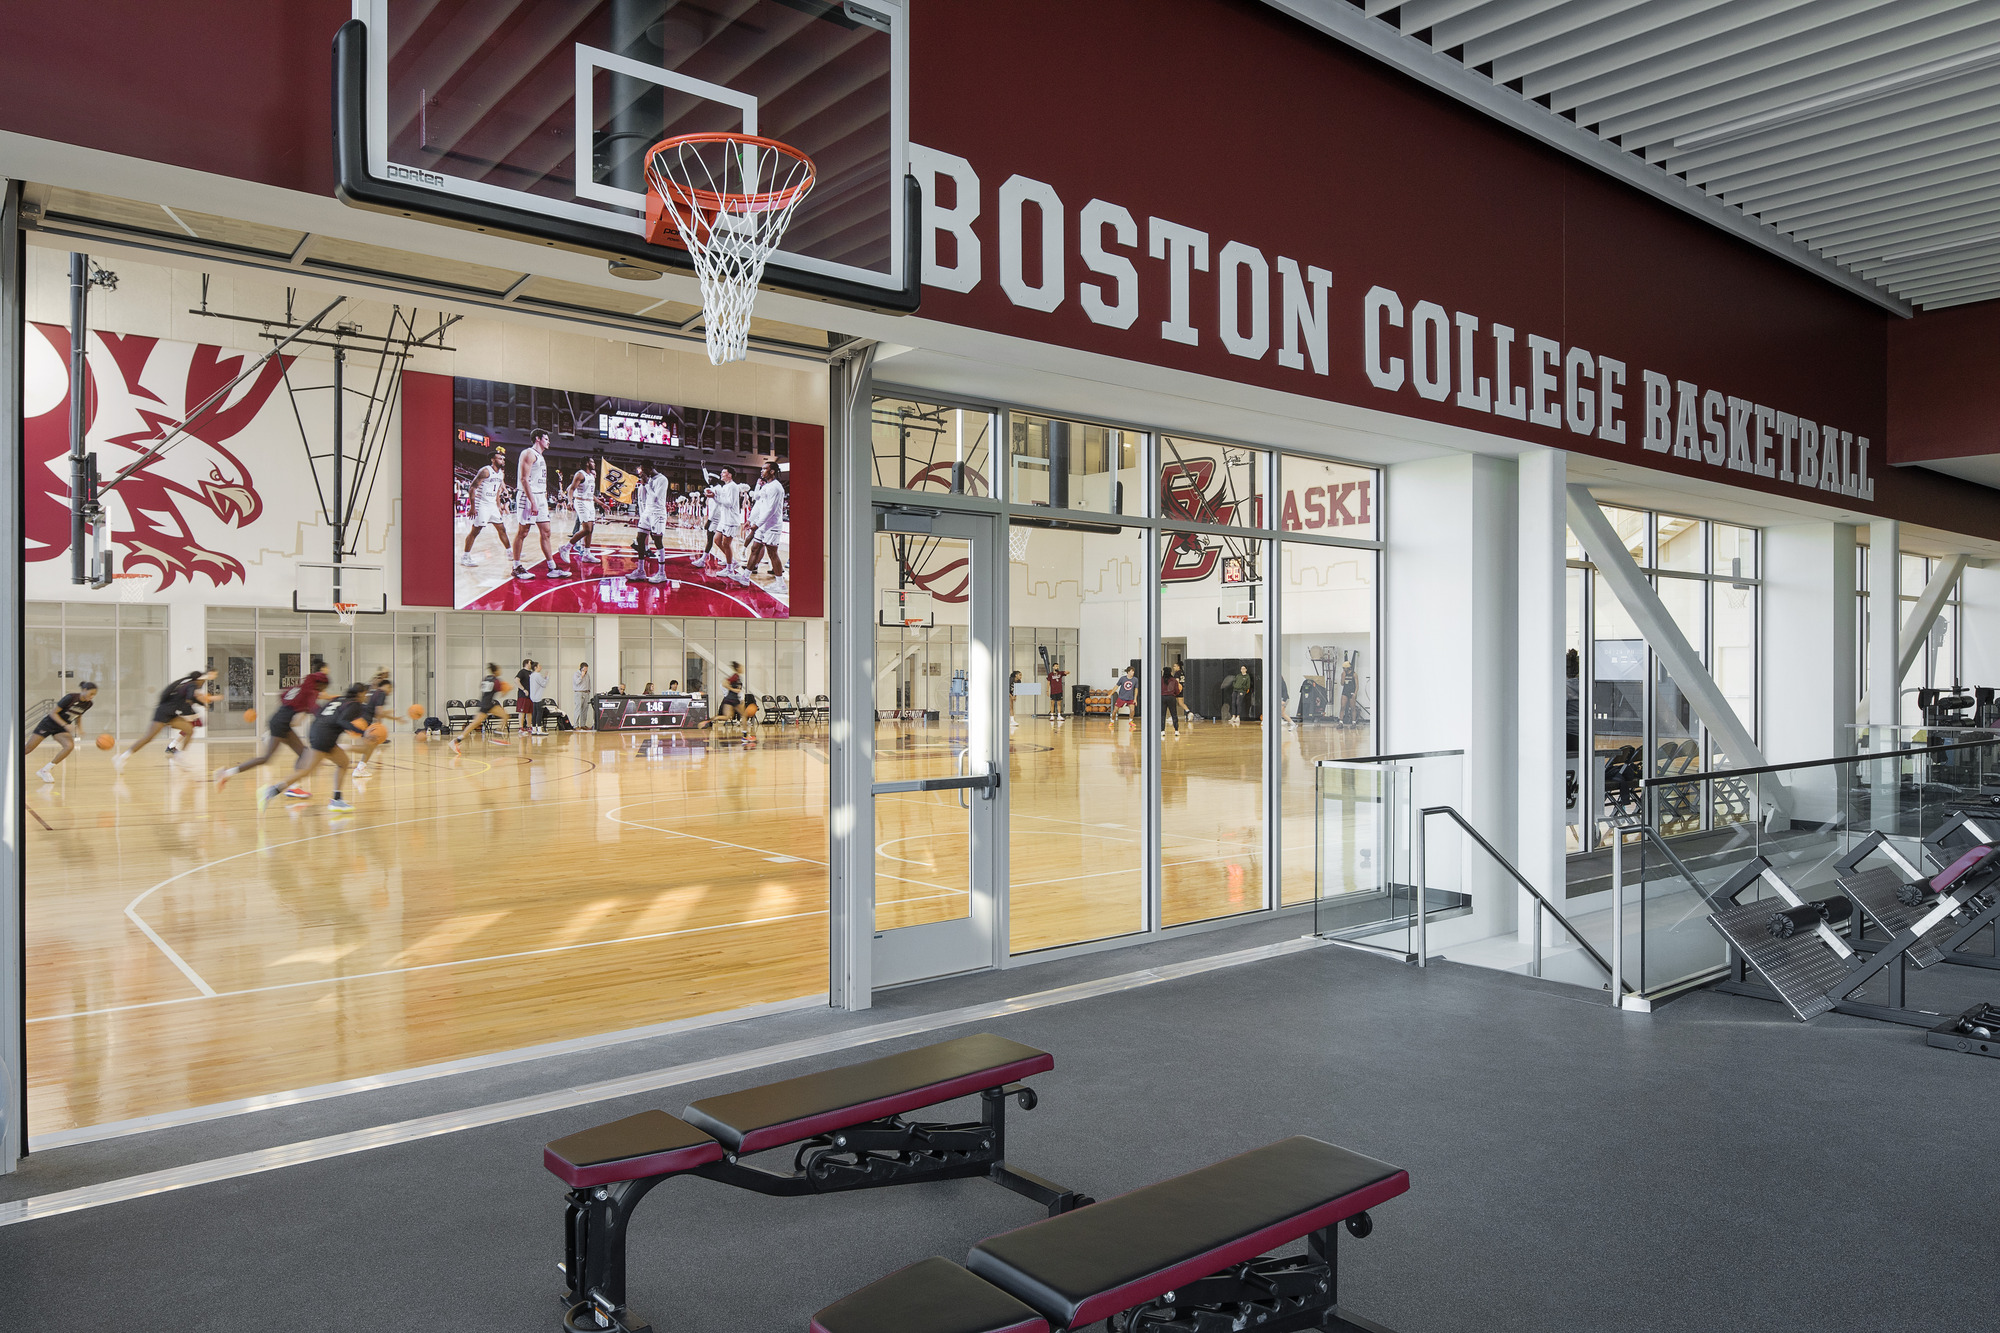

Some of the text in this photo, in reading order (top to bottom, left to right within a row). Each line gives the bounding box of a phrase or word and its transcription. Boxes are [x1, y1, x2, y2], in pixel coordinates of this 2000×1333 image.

[387, 165, 444, 187] porter
[909, 142, 1874, 502] BOSTON COLLEGE BASKETBALL
[646, 701, 663, 712] 1:46
[651, 717, 658, 725] 26
